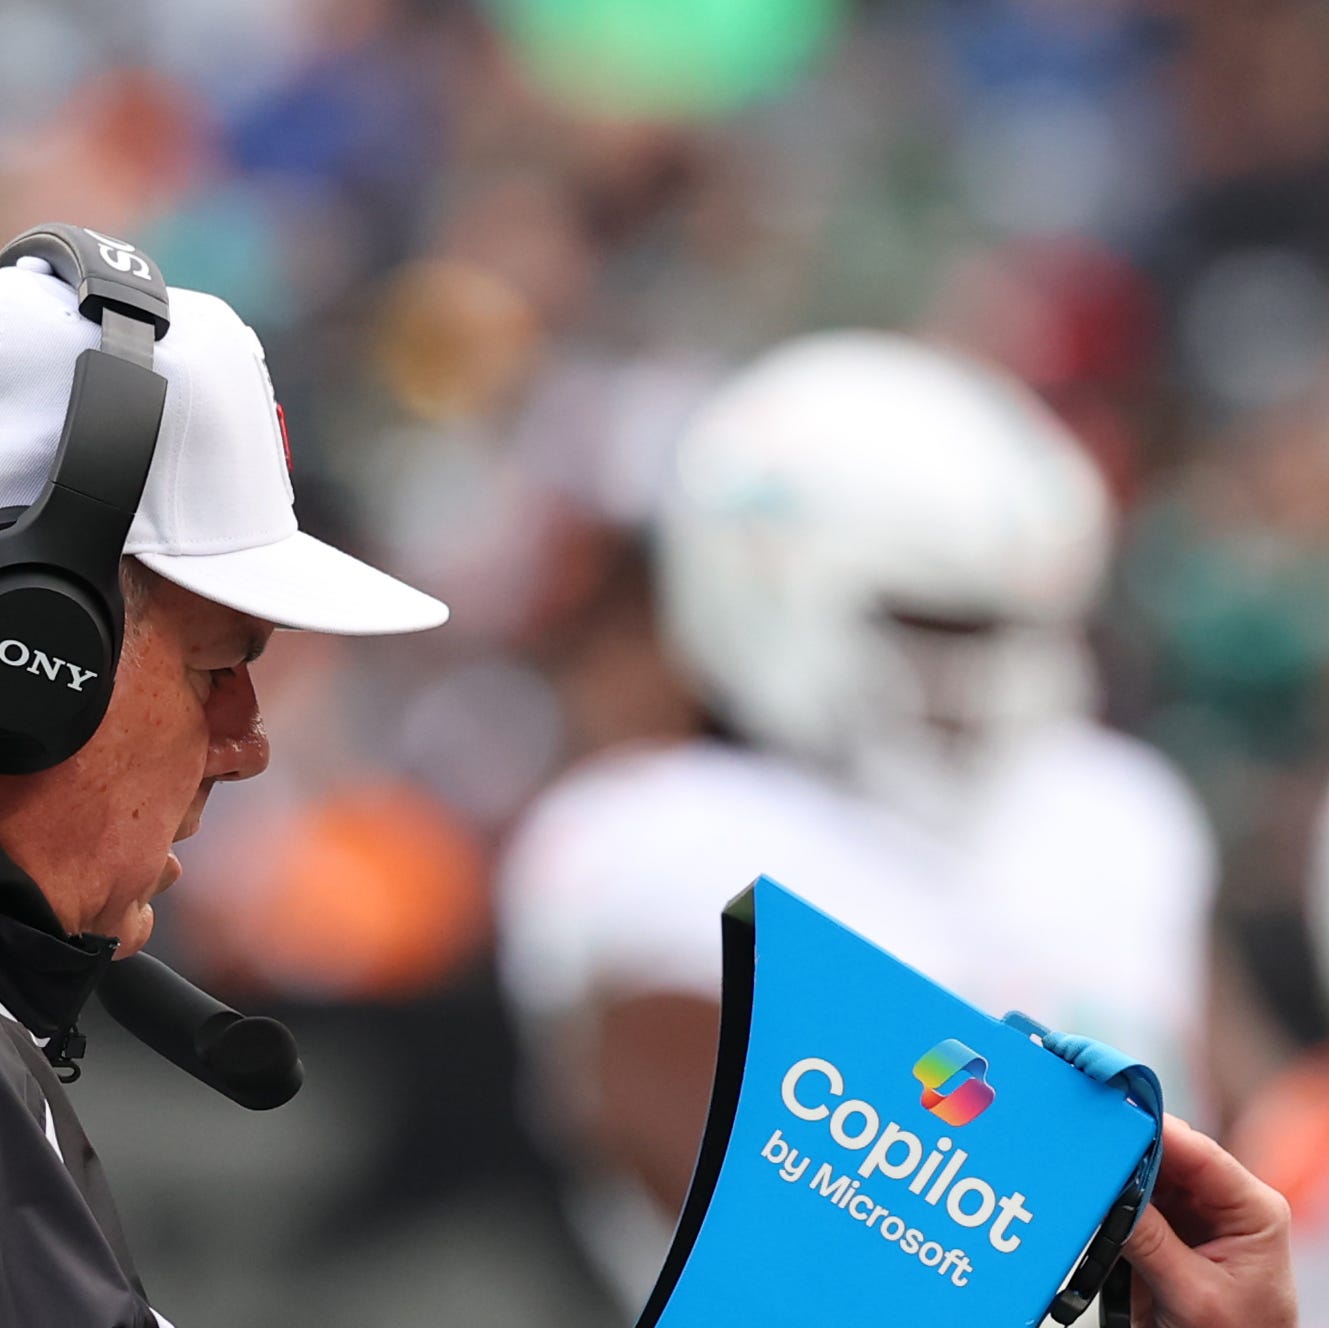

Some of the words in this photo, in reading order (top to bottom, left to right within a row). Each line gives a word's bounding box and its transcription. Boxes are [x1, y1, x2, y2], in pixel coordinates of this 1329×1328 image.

[760, 1129, 812, 1183] by
[808, 1162, 974, 1288] Microsoft
[780, 1056, 1034, 1254] Copilot
